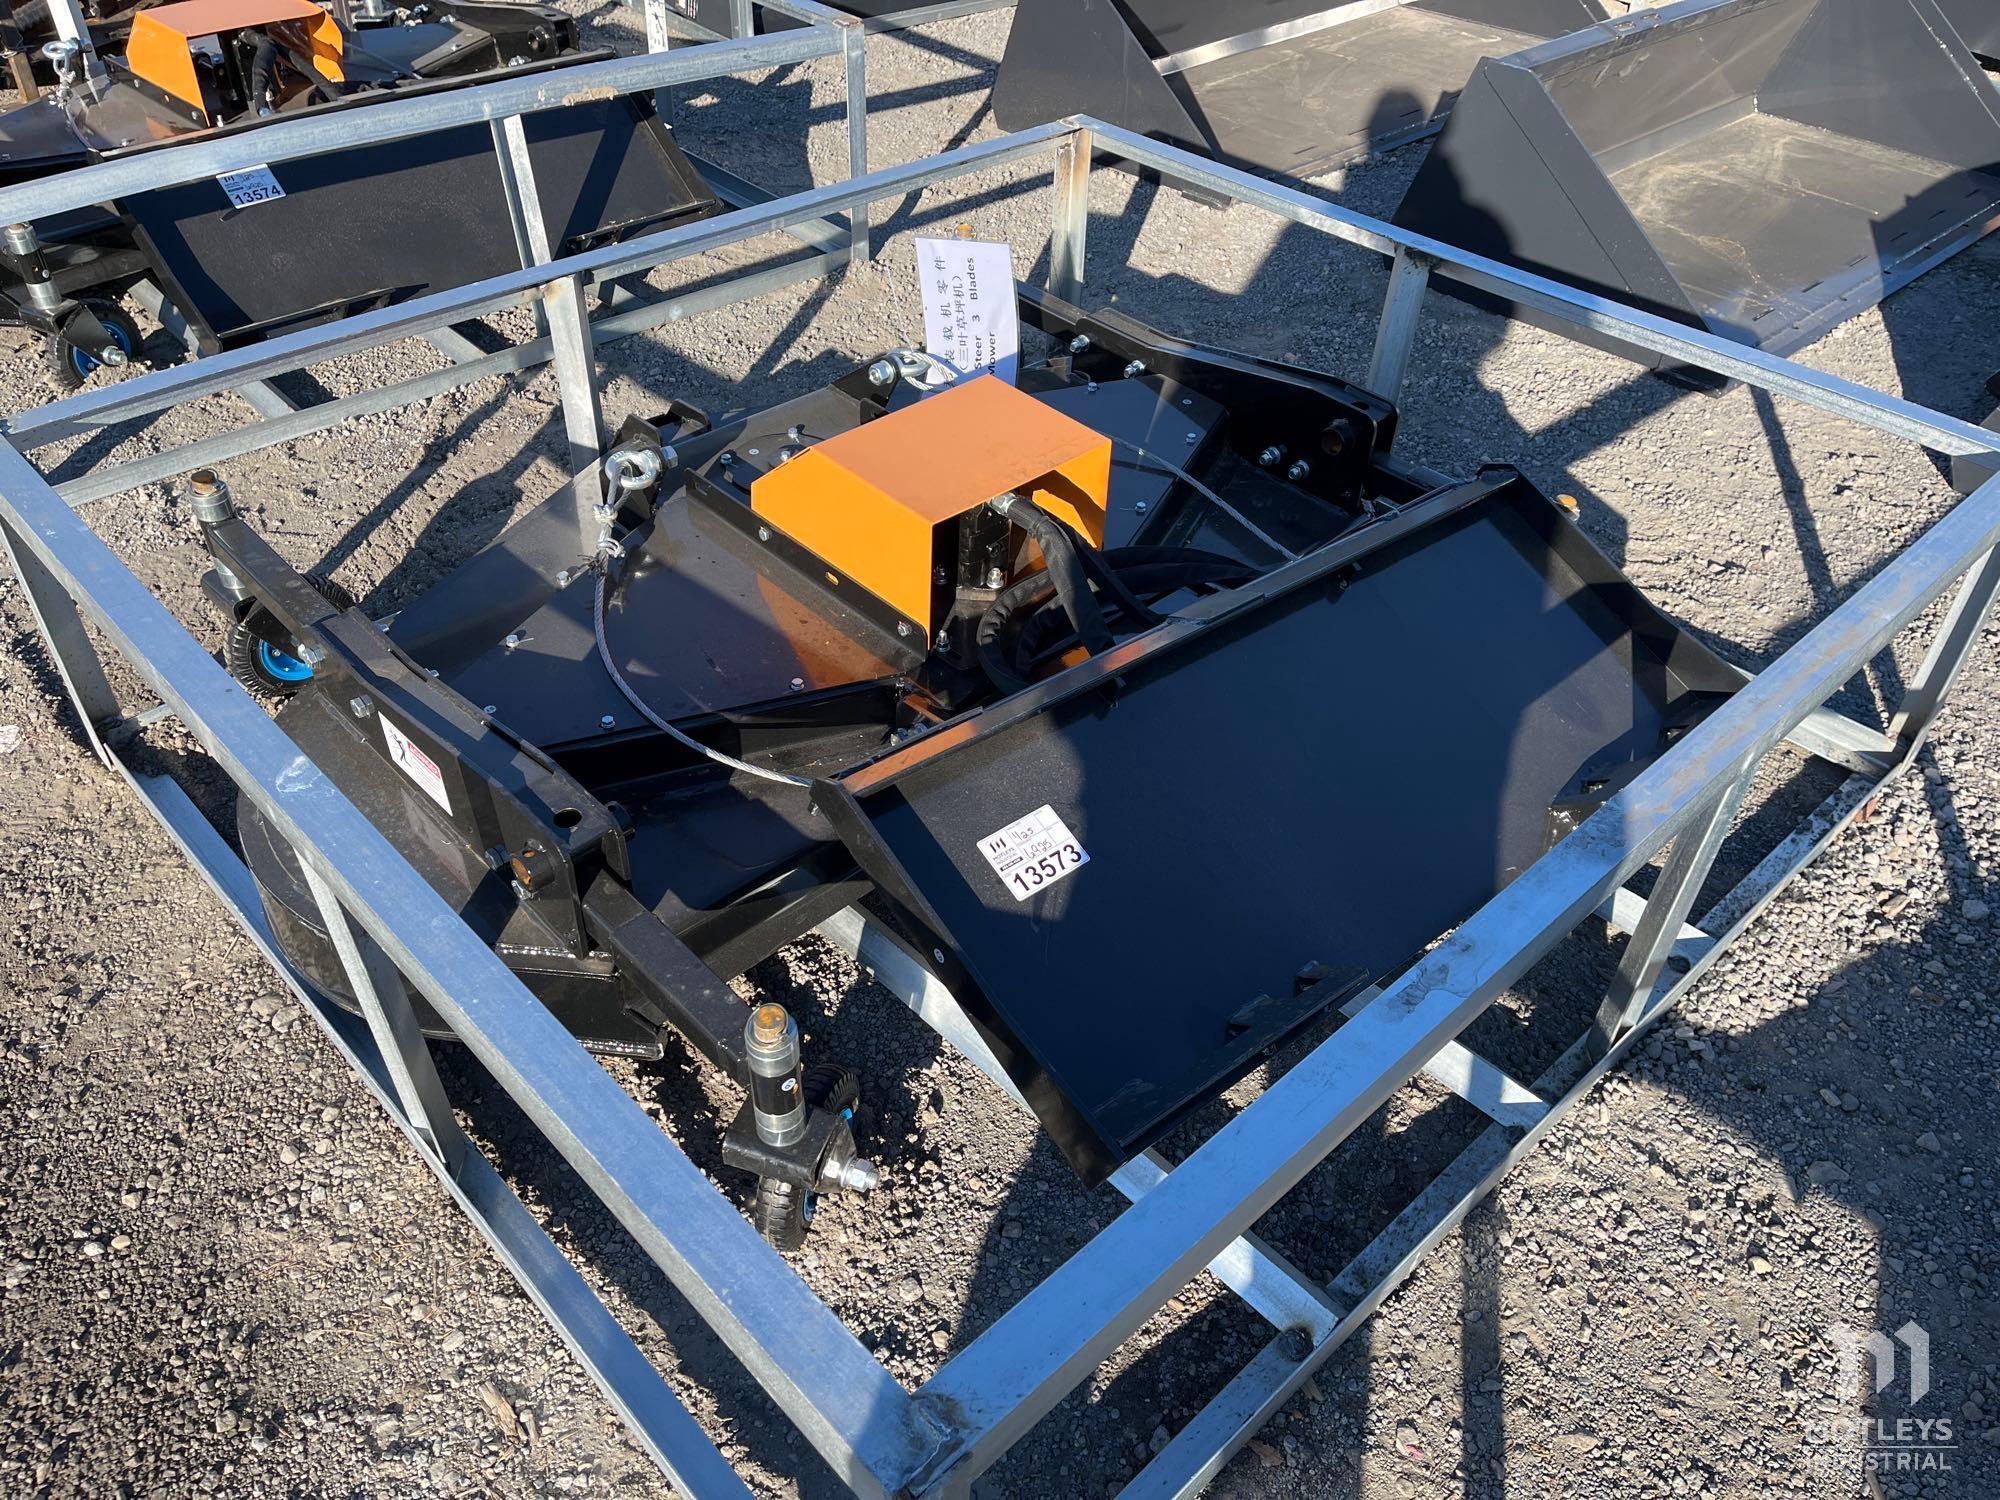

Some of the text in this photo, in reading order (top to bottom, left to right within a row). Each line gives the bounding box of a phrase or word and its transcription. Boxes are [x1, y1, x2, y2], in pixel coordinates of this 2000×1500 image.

[235, 184, 280, 204] 13574
[966, 257, 982, 370] Steer 3 Blades
[987, 331, 997, 376] Mower
[1013, 844, 1082, 892] 13573
